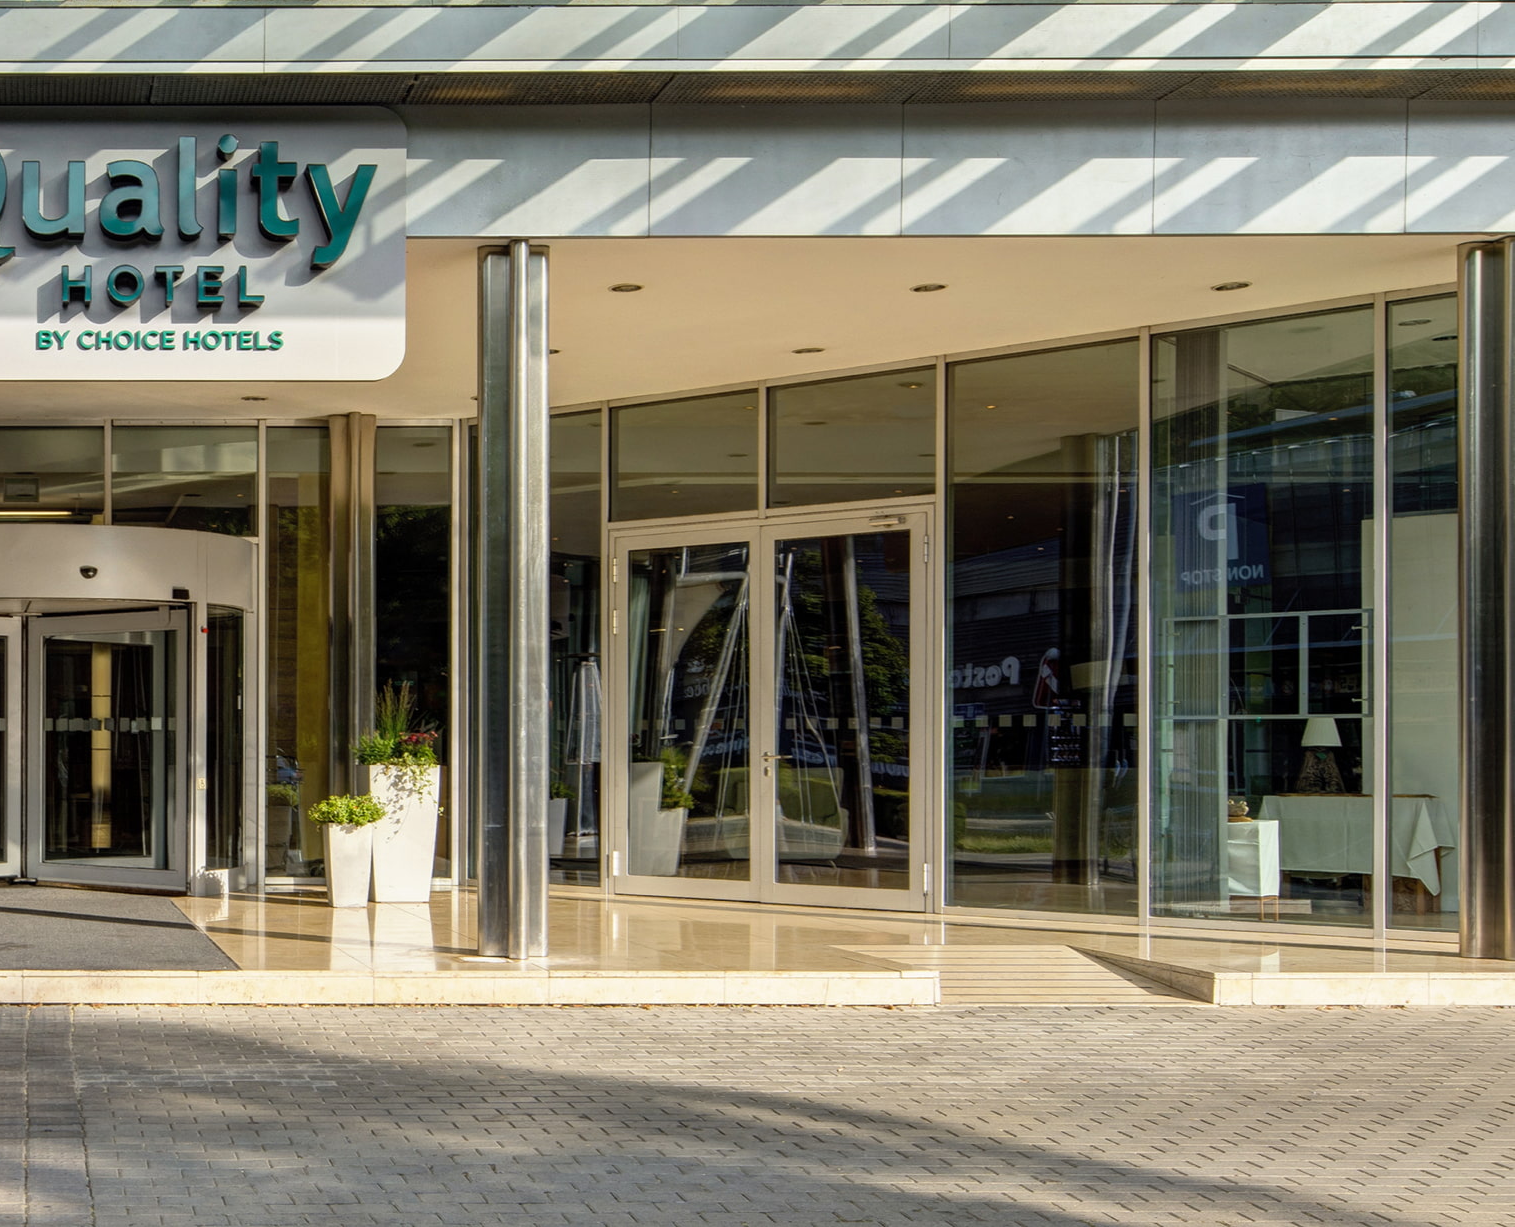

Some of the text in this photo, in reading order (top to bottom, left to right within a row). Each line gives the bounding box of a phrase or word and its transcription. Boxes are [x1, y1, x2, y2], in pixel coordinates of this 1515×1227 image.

[61, 264, 265, 308] HOTEL
[36, 329, 284, 351] BY CHOICE HOTELS
